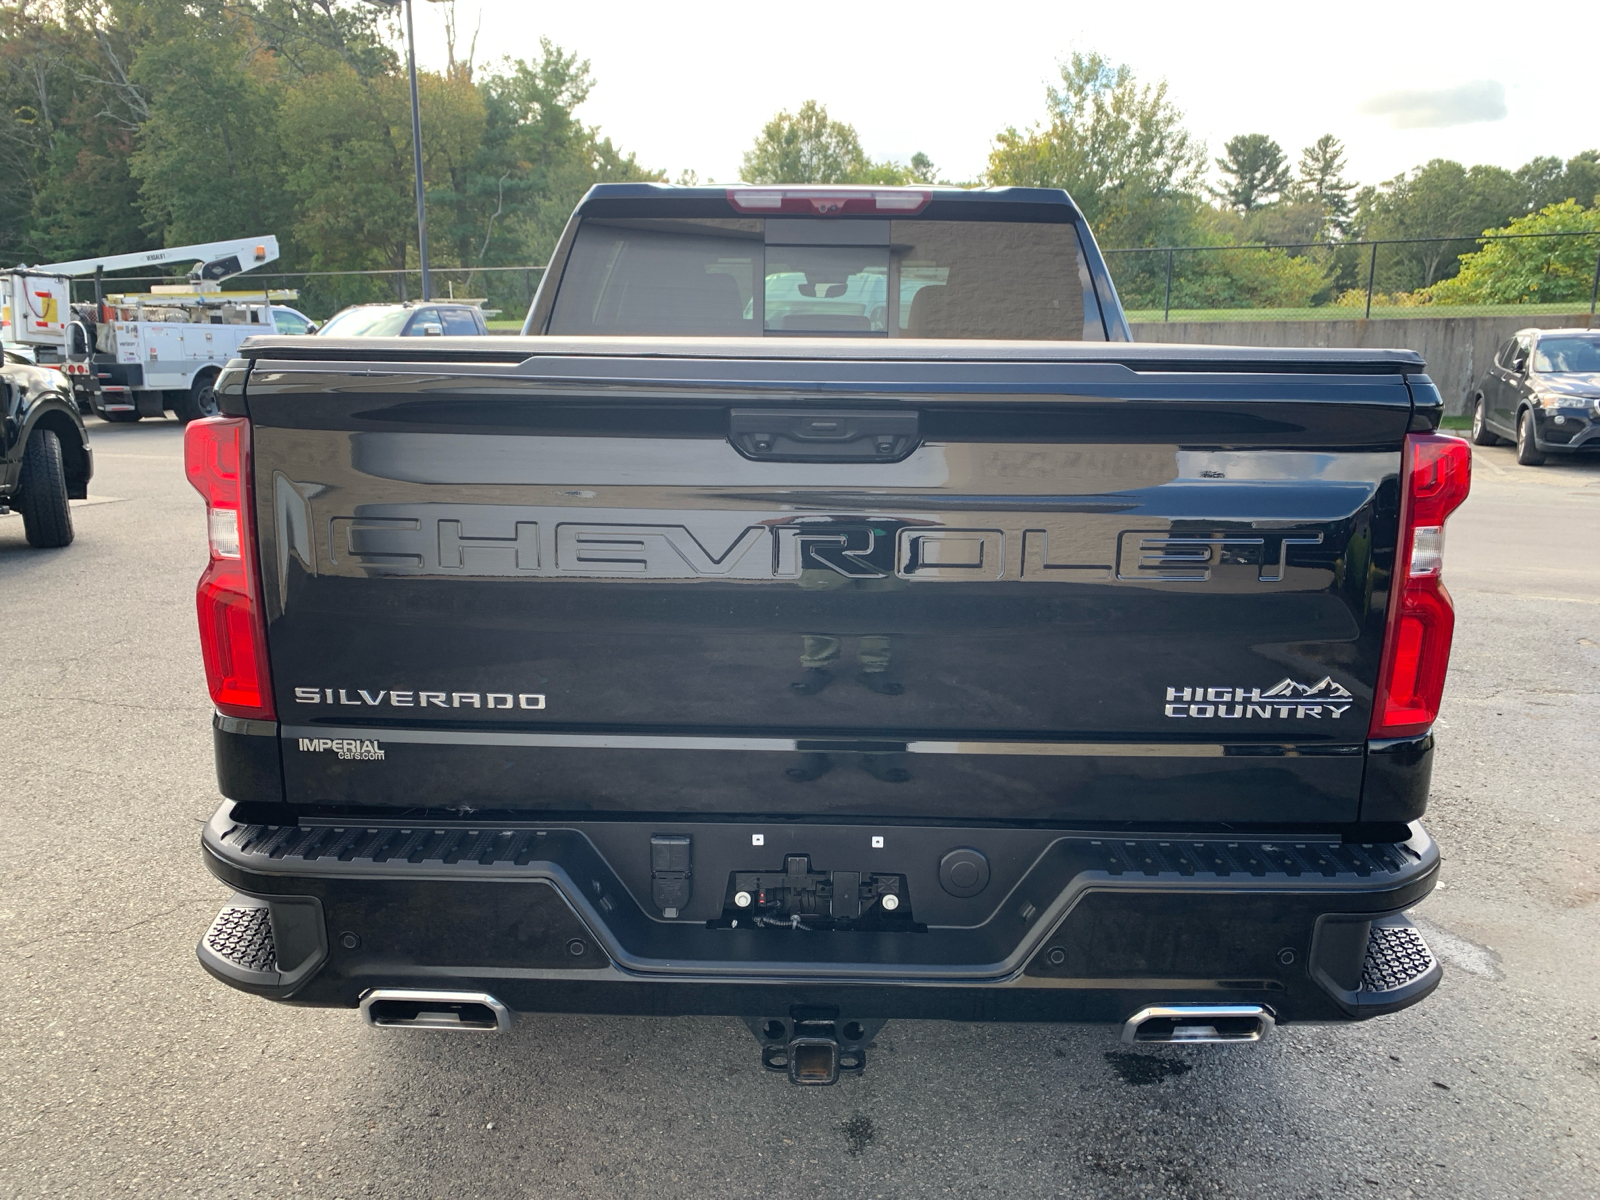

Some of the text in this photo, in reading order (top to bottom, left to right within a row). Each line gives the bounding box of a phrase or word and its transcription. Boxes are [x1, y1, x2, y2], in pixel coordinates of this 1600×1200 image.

[328, 516, 1324, 582] CHEVROLET
[294, 687, 546, 710] SILVERADO
[1165, 686, 1262, 702] HIGH
[1164, 704, 1352, 719] COUNTRY
[298, 738, 385, 754] IMPERIAL
[337, 750, 385, 760] cars.com
